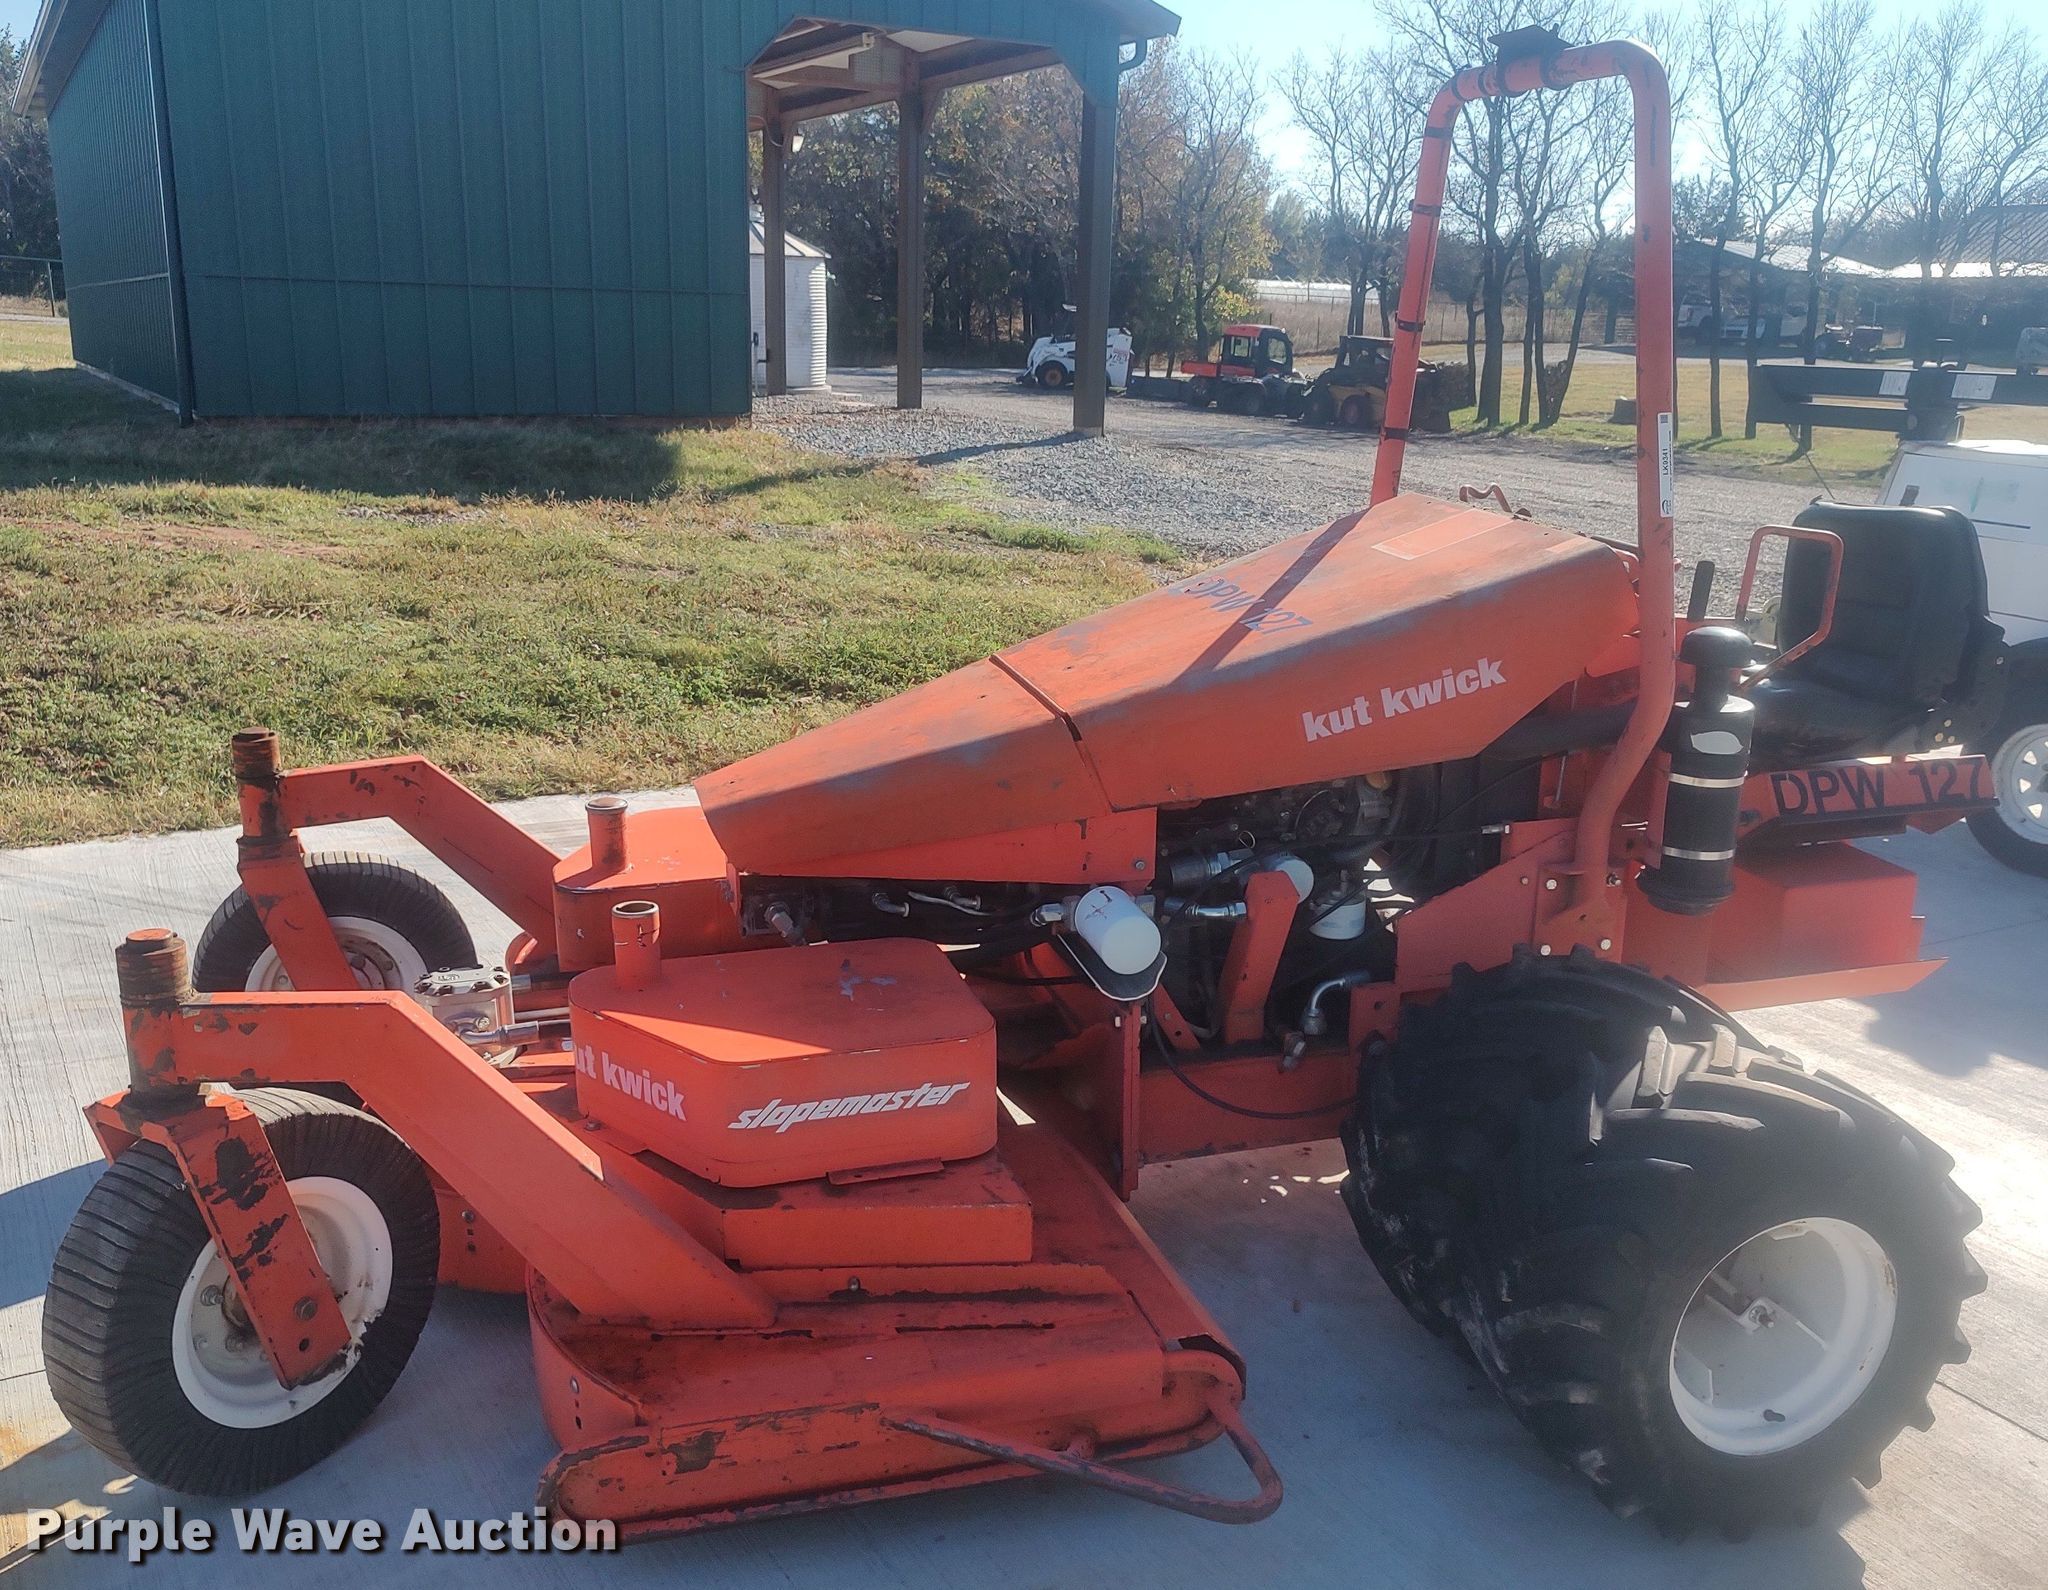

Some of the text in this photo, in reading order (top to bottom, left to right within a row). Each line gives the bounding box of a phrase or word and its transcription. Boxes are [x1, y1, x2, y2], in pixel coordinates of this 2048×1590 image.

[1184, 577, 1313, 634] DPW 127
[1302, 657, 1506, 742] kut kwick
[1770, 758, 1985, 816] DPW 127
[576, 1045, 687, 1121] ut kwick
[727, 1082, 971, 1133] slopemaster
